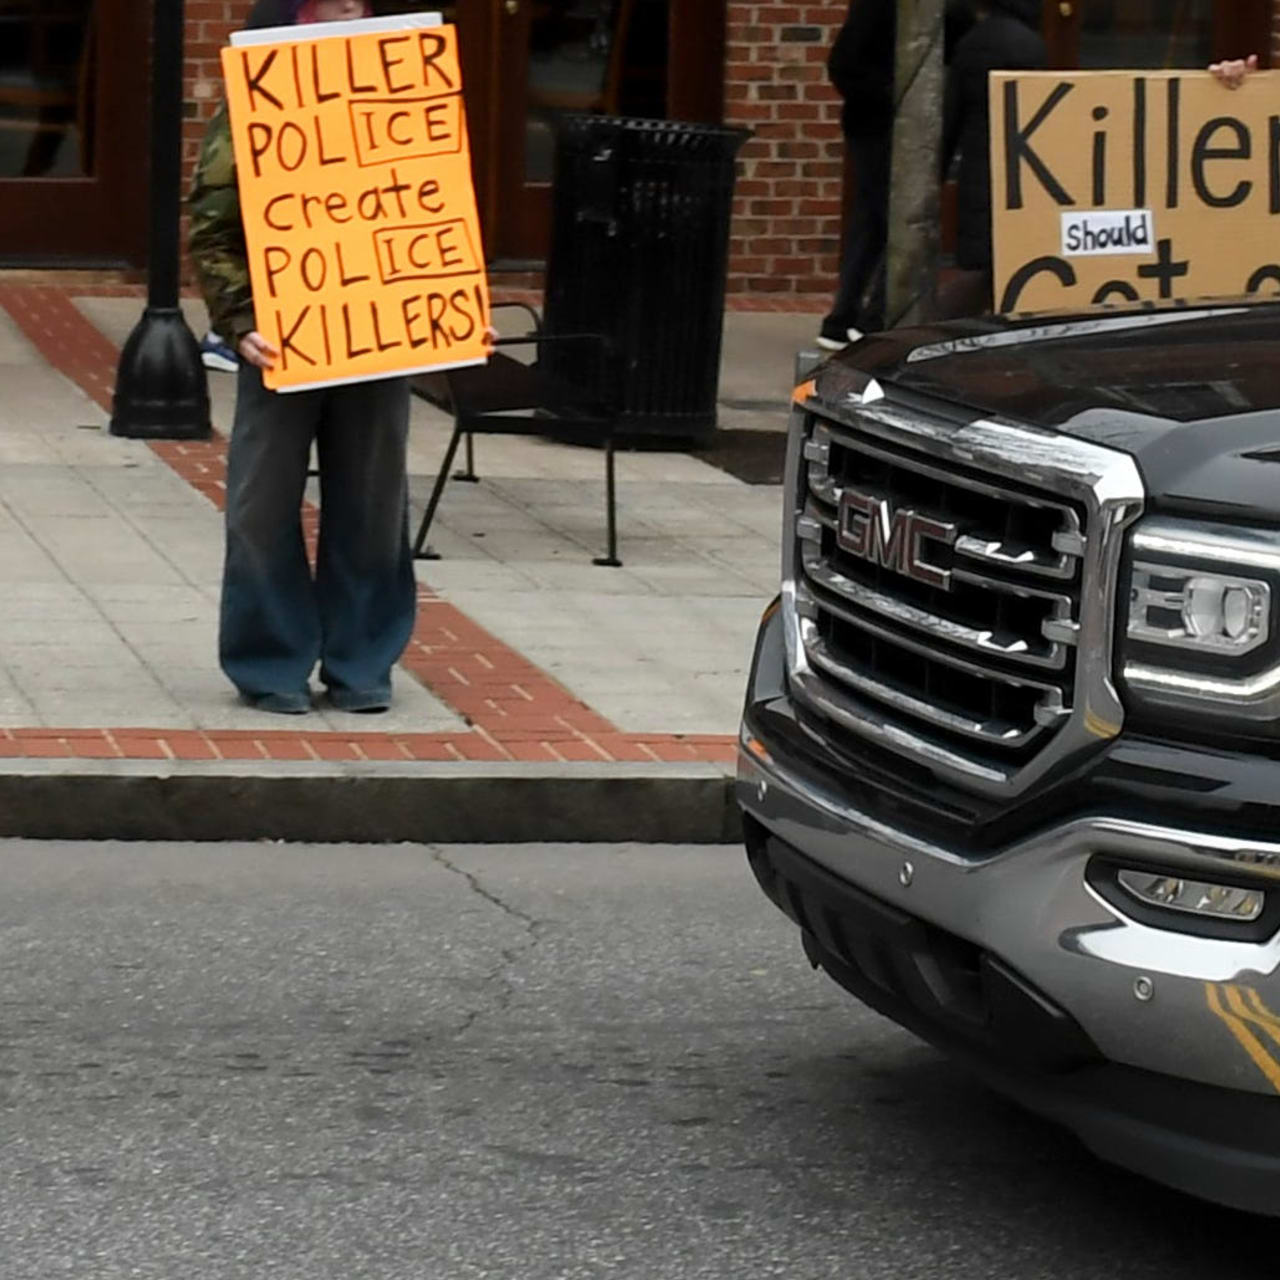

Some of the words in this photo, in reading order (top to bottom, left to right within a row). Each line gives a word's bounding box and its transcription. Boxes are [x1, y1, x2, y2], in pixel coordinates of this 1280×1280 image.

[241, 32, 454, 112] KILLER
[246, 103, 452, 178] POLICE
[263, 168, 445, 231] create
[1065, 214, 1149, 252] Should
[263, 226, 468, 297] POLICE
[275, 284, 491, 371] KILLERS!
[836, 487, 957, 592] GMC
